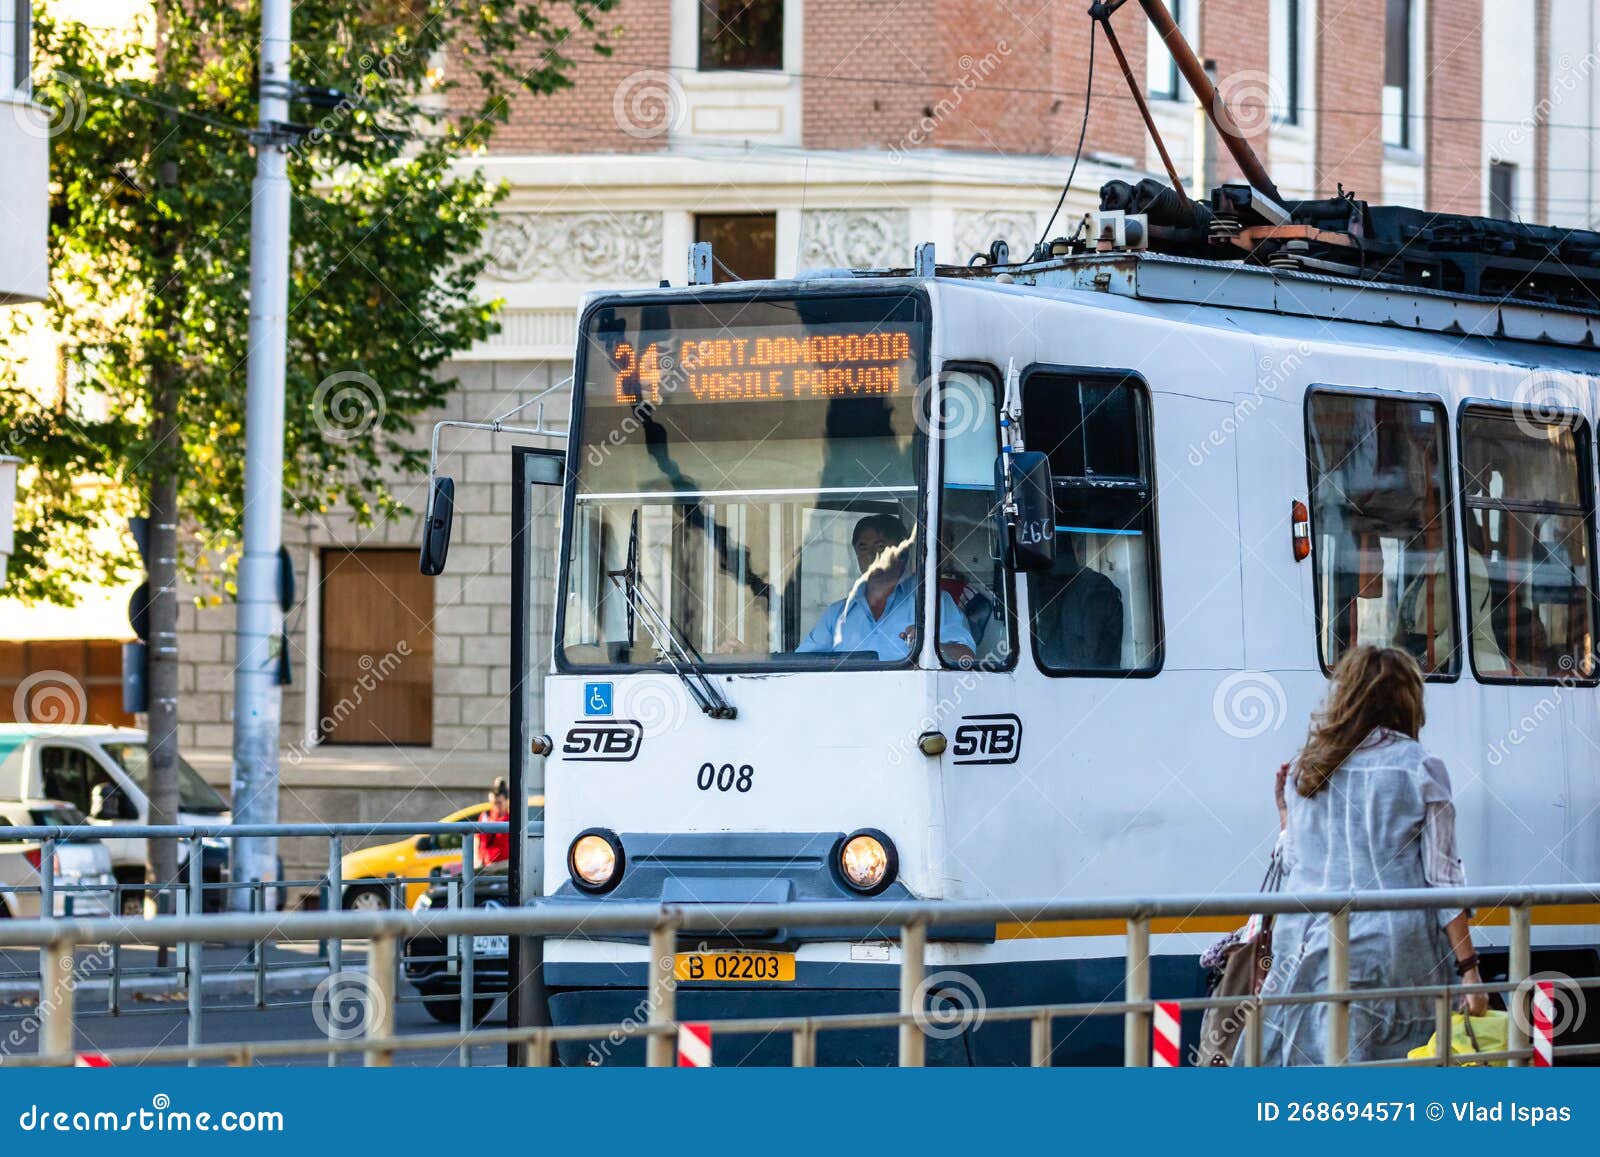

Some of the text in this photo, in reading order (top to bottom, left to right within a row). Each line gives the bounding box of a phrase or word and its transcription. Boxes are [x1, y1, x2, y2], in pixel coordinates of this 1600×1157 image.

[615, 343, 661, 403] 24
[689, 371, 784, 400] VASILE
[562, 727, 636, 754] STB
[953, 723, 1015, 756] STB
[697, 762, 754, 792] 008
[690, 956, 779, 979] B 02203
